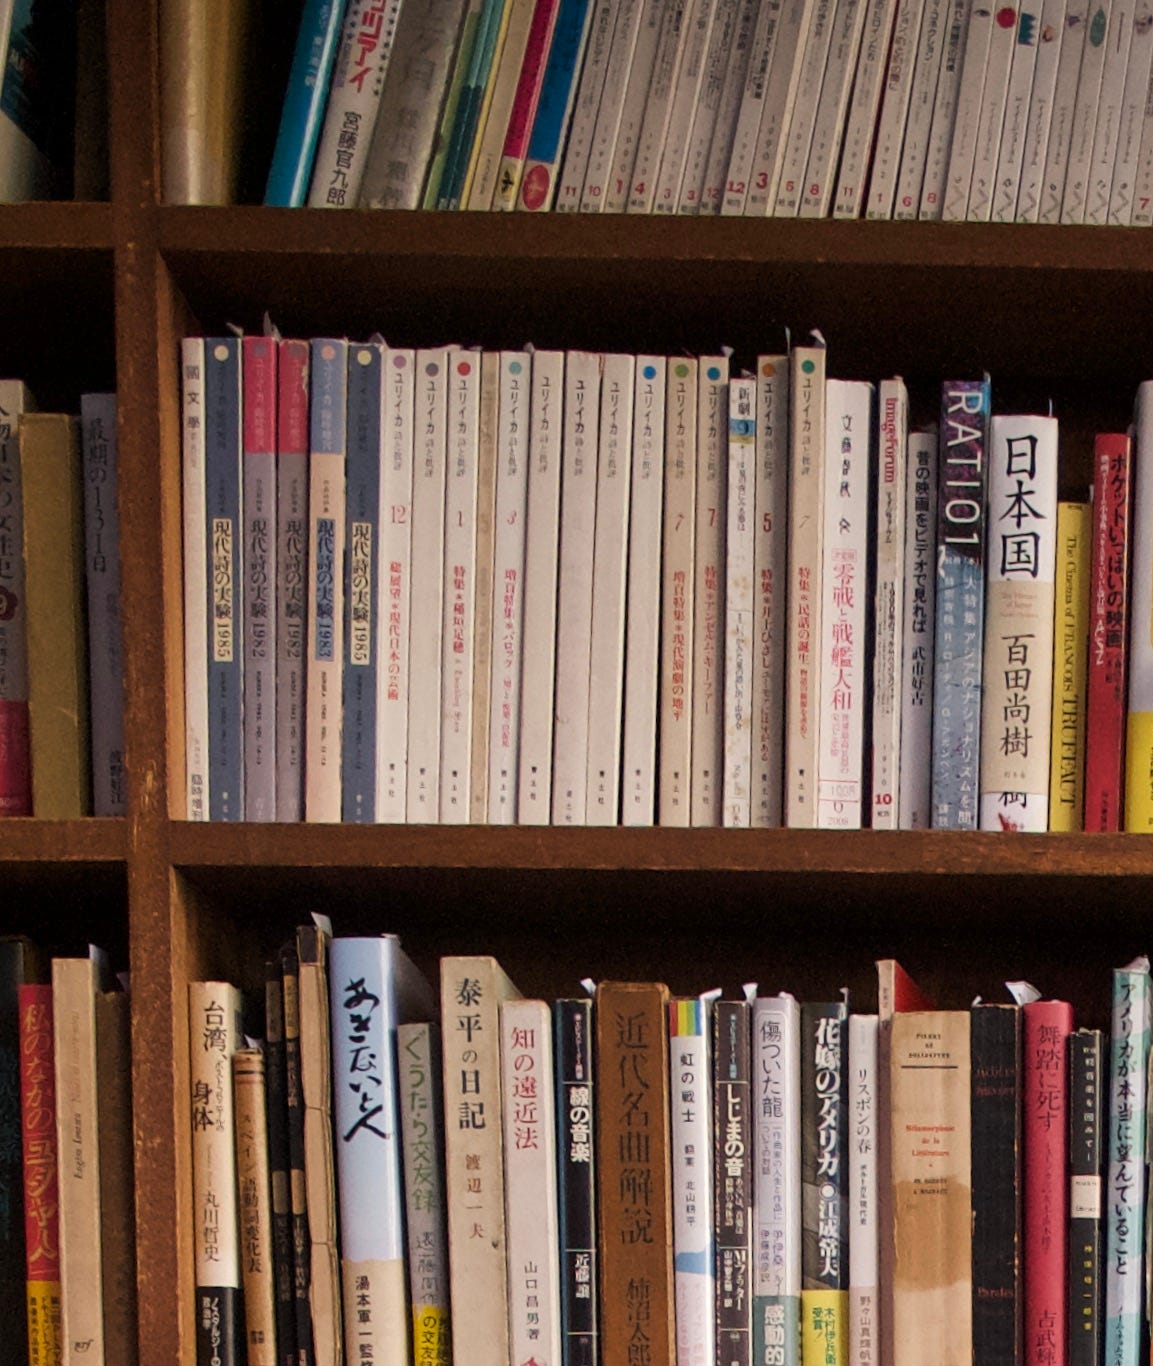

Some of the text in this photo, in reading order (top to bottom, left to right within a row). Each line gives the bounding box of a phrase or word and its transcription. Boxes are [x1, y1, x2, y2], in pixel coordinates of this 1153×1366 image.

[754, 171, 769, 191] 3
[1138, 197, 1150, 210] 7
[425, 380, 436, 435] ユリイカ
[458, 380, 469, 435] ユリイカ
[509, 380, 520, 433] ユリイカ
[391, 506, 407, 525] 12
[708, 508, 716, 527] 7
[763, 513, 772, 532] 5
[913, 450, 931, 633] 昔の映画をビデオで見れば
[998, 434, 1046, 578] 日本国
[1063, 536, 1077, 554] The
[1064, 558, 1077, 597] Cinema
[1064, 604, 1075, 622] of
[1000, 634, 1036, 759] 百田尚樹
[875, 793, 893, 804] 10
[455, 977, 486, 1131] 泰平の日記
[680, 1052, 695, 1124] 虹の戦士
[759, 1020, 783, 1119] 傷ついた龍
[1036, 1023, 1061, 1131] 舞踏に死す
[193, 1079, 214, 1132] 身体
[403, 1030, 438, 1214] ぐうたら交友録
[569, 1086, 590, 1163] 線の音楽
[725, 1085, 744, 1177] しじまの音
[814, 1017, 841, 1177] 花嫁のアメリカ
[855, 1069, 872, 1154] リスボンの春
[1112, 982, 1137, 1276] アメリカが本当に望んでいること
[511, 1027, 539, 1340] 知の遠近法 山口昌男著
